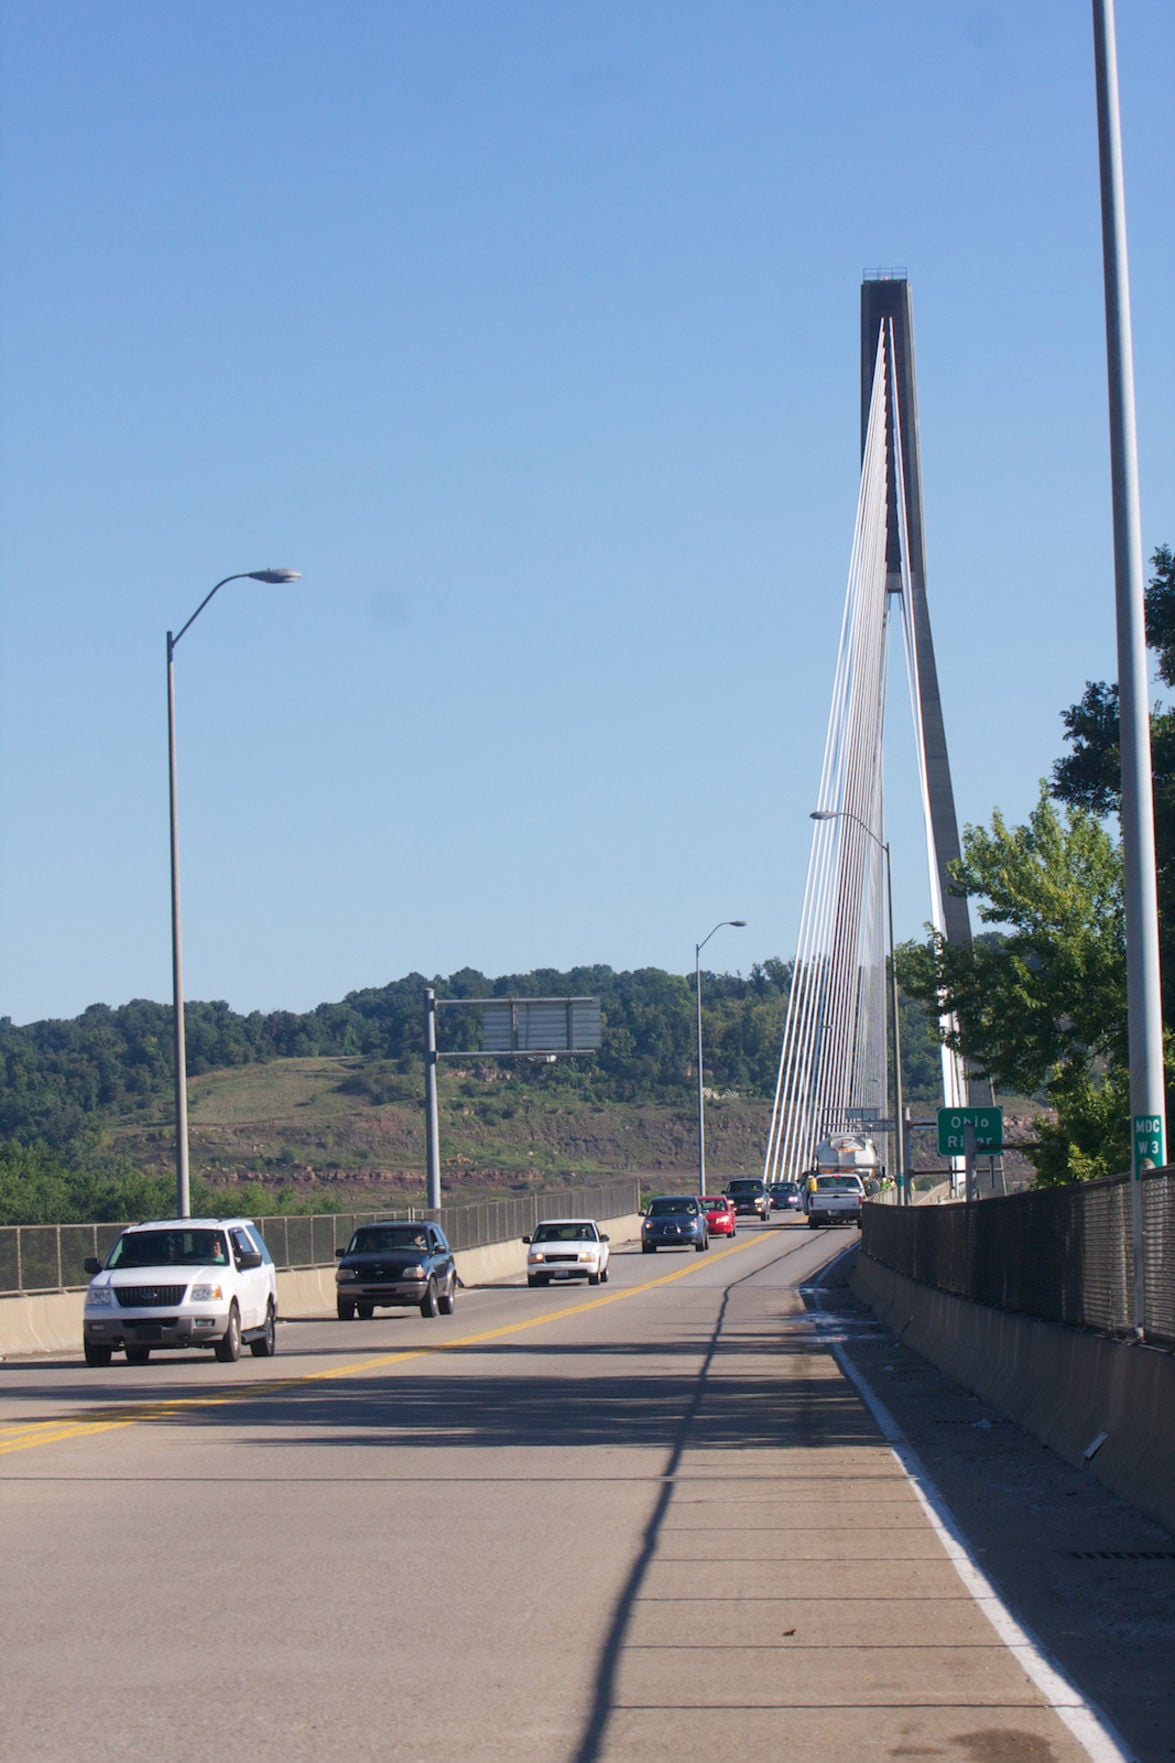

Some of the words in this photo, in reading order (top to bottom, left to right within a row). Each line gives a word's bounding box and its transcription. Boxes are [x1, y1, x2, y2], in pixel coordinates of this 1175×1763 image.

[951, 1115, 989, 1128] Ohio
[1136, 1119, 1160, 1133] MDC
[947, 1135, 992, 1148] Rier
[1151, 1140, 1159, 1154] 3
